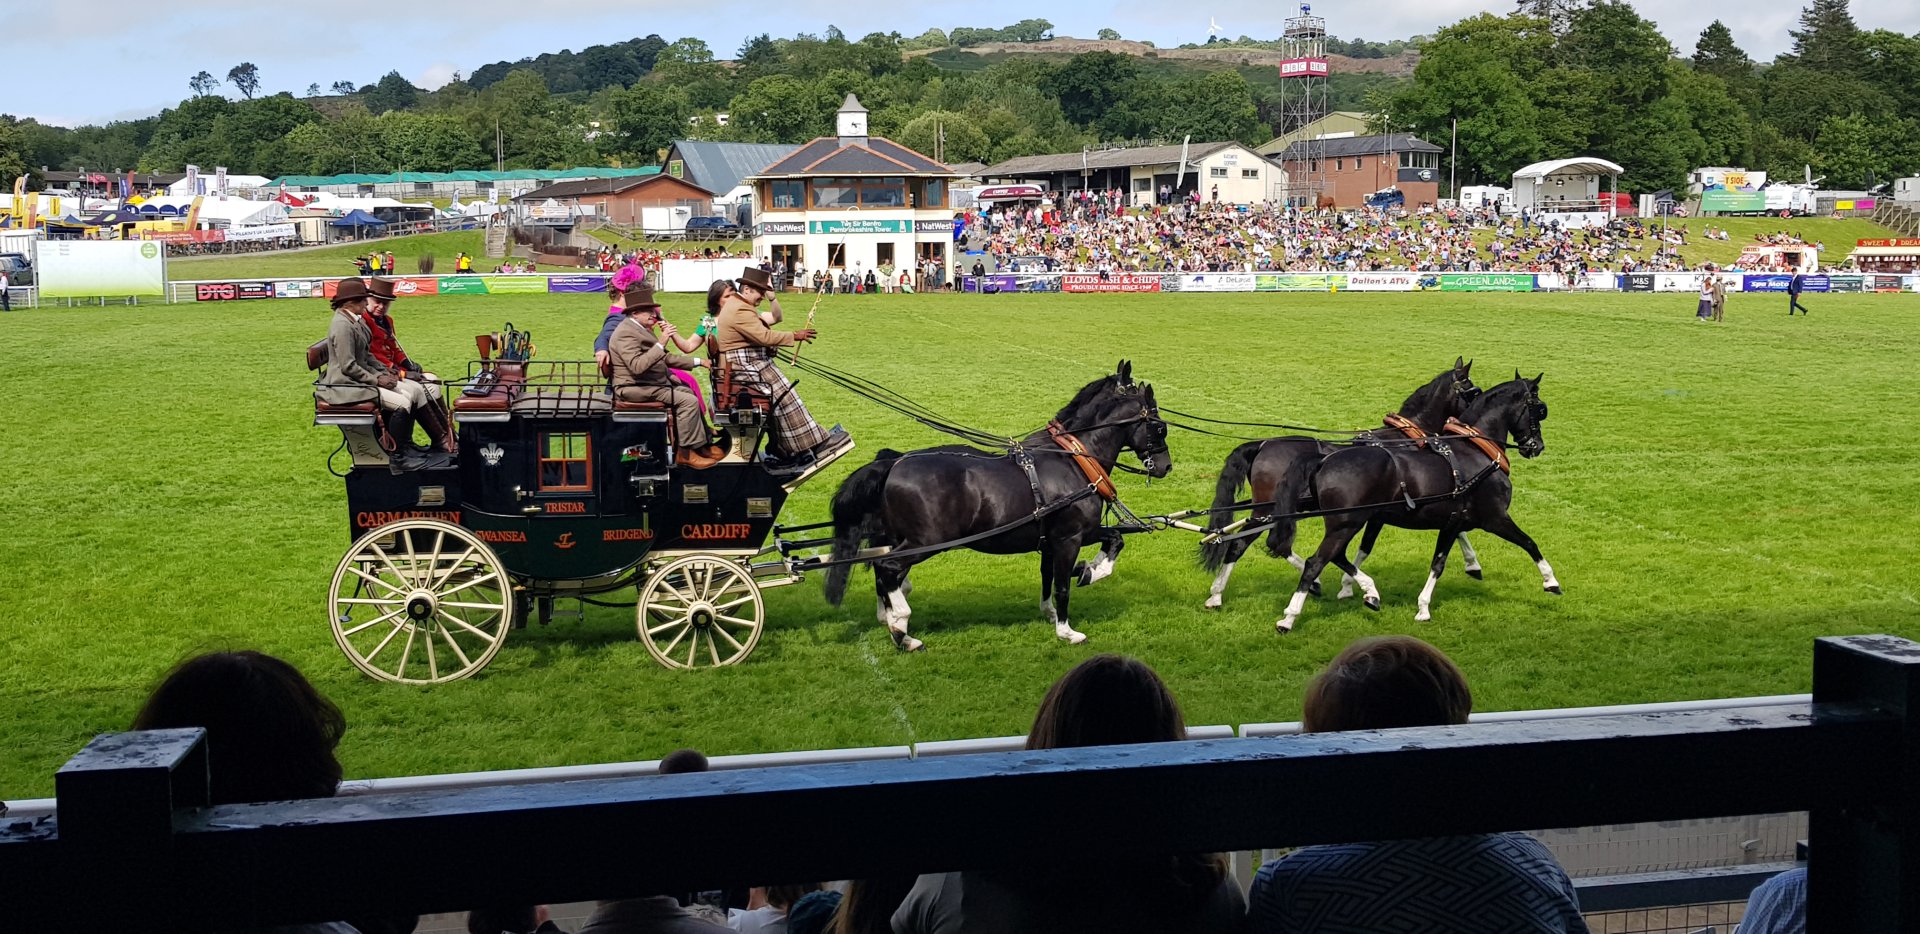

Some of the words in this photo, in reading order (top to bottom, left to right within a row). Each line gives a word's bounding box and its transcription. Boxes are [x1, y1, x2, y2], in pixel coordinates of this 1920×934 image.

[1283, 62, 1306, 72] BBC
[773, 224, 805, 232] NatWest
[922, 222, 952, 230] NatWest
[1064, 276, 1099, 284] LLOYDS
[1123, 276, 1131, 284] &
[1132, 276, 1158, 284] CHIPS
[1633, 277, 1649, 285] M&S
[198, 284, 235, 300] DTG
[545, 502, 586, 513] TRISTAR
[603, 529, 654, 541] BRIDGEND
[681, 523, 751, 539] CARDIFF
[475, 530, 528, 543] SWANSEA
